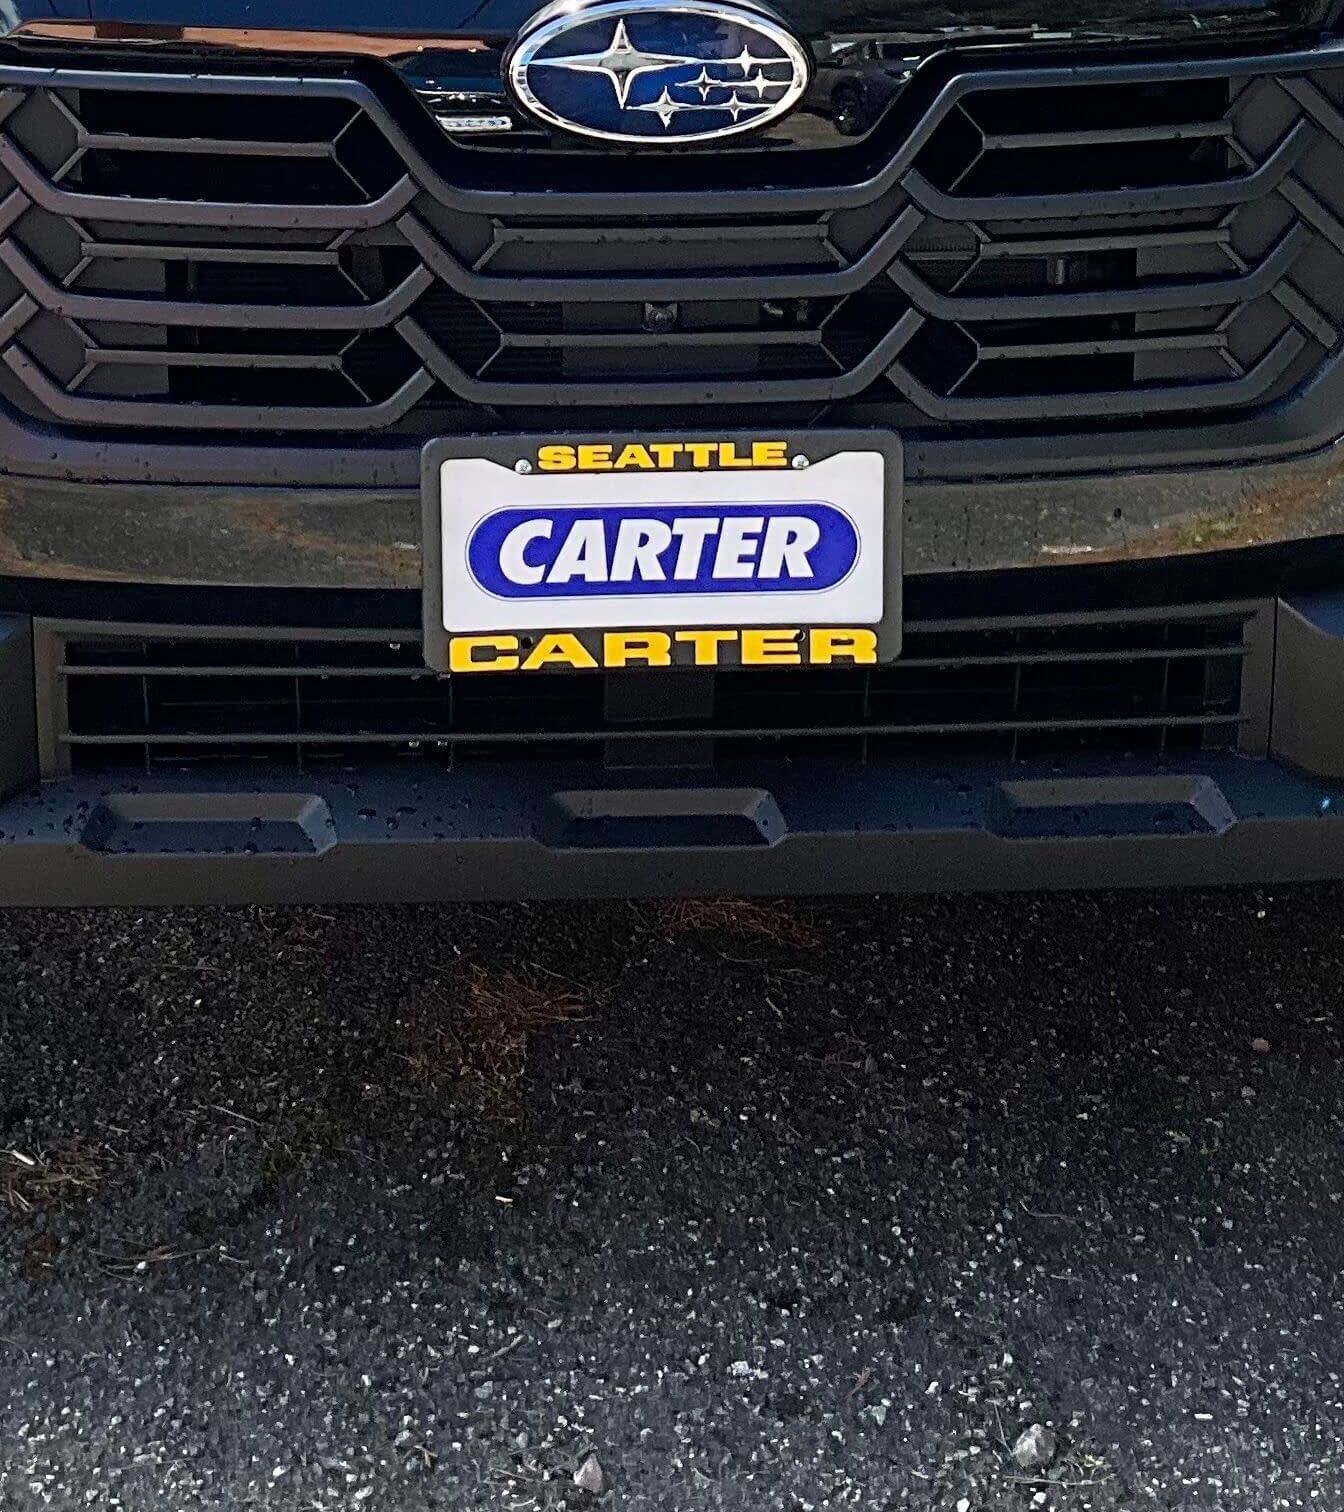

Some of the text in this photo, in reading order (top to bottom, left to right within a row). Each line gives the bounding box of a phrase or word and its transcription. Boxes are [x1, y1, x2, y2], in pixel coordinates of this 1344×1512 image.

[537, 441, 788, 472] SEATTLE
[498, 516, 821, 586] CARTER
[448, 628, 878, 673] CARTER
